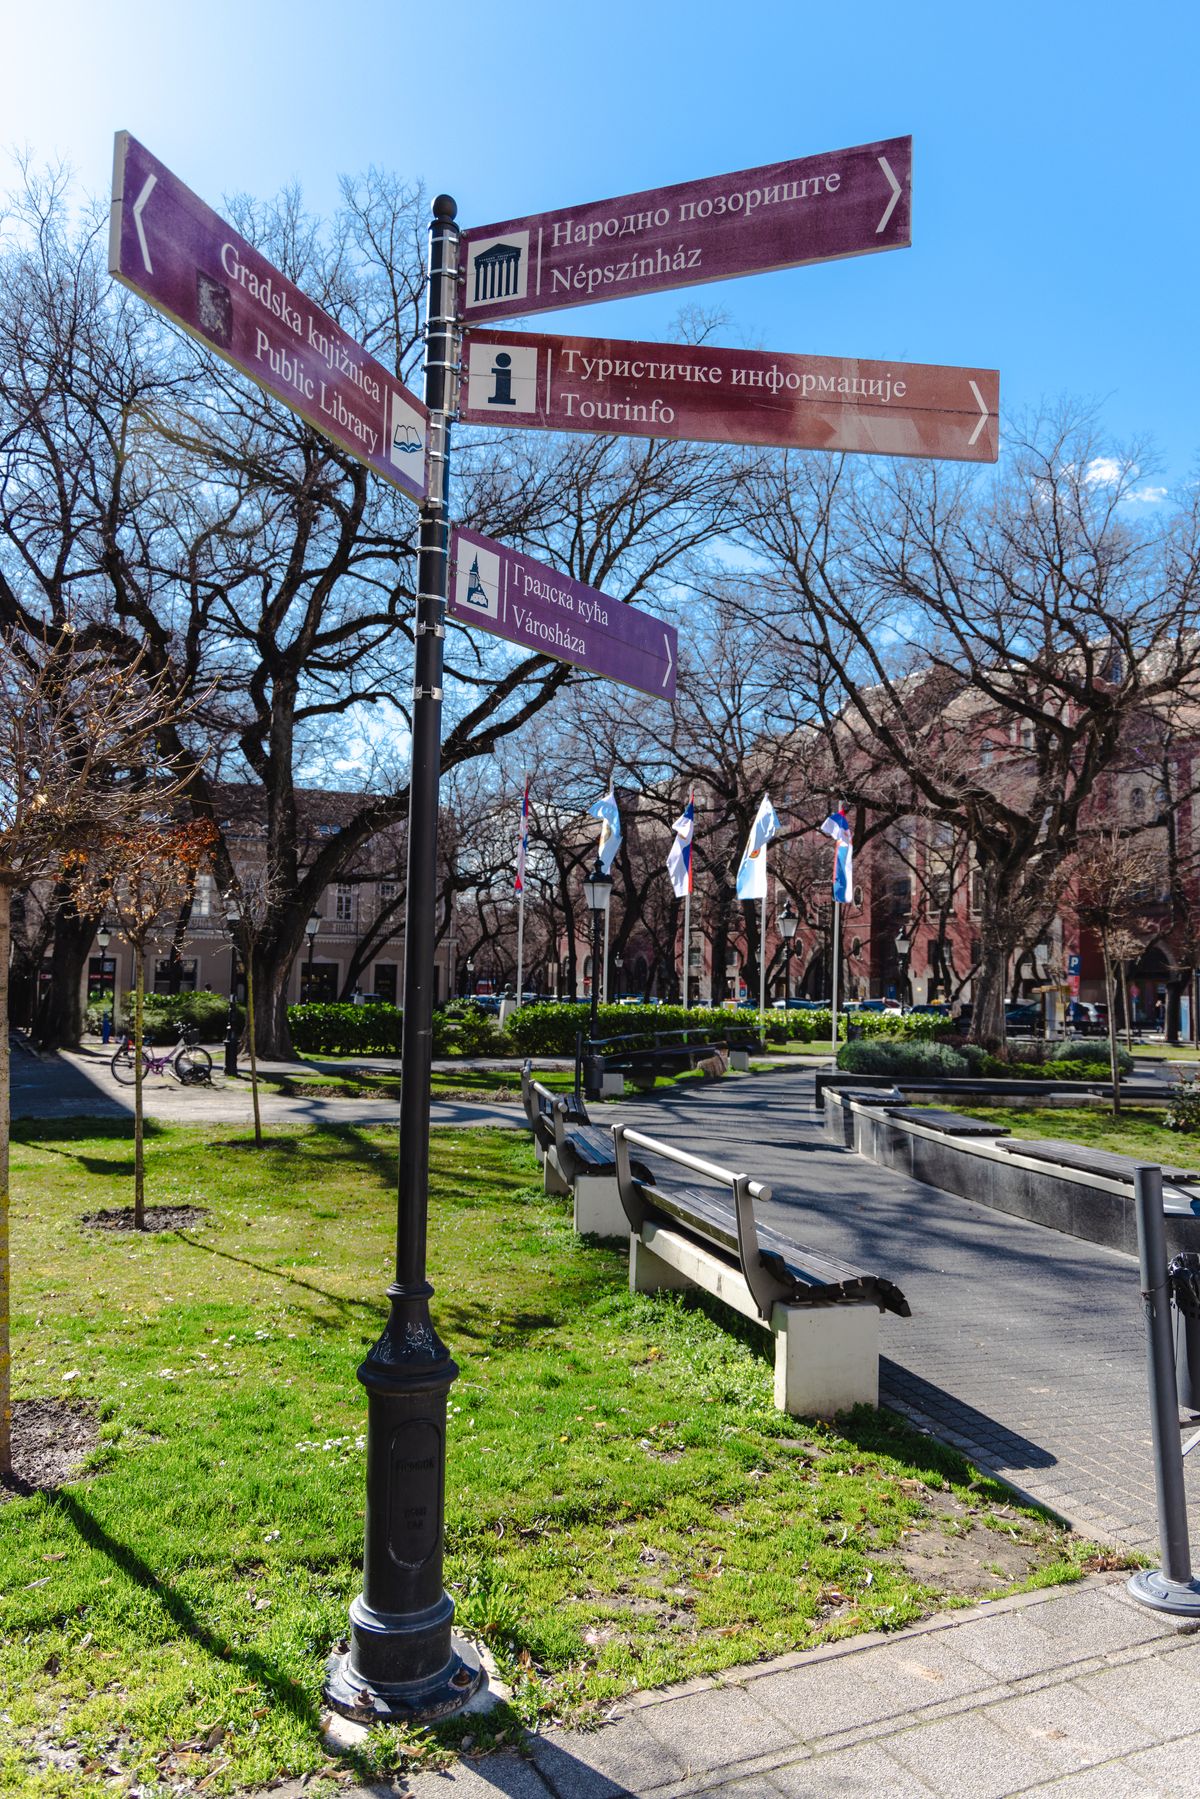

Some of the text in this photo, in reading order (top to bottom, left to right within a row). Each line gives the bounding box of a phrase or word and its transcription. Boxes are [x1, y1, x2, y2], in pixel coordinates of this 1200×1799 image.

[551, 173, 841, 248] Народно позориште
[550, 245, 702, 294] Népszínház
[220, 243, 380, 403] Gradska knjižnica
[255, 328, 379, 454] Public Library
[561, 349, 907, 403] Туристичке информације
[560, 393, 675, 424] Tourinfo
[512, 562, 609, 626] Градска кућа
[512, 604, 586, 655] Városháza
[1071, 957, 1079, 967] P
